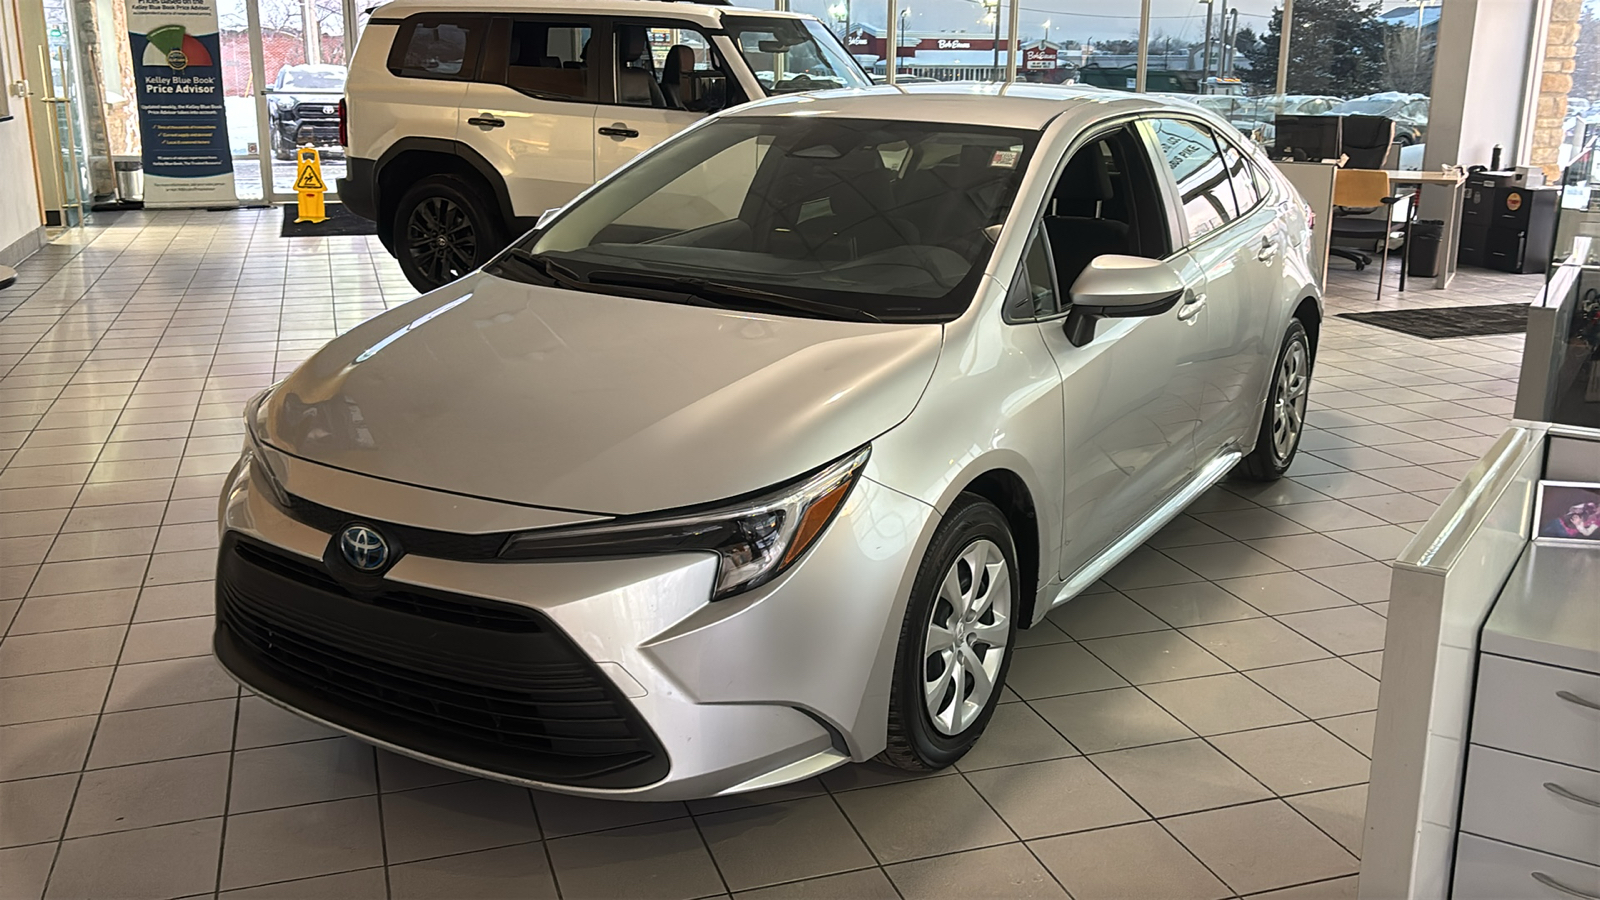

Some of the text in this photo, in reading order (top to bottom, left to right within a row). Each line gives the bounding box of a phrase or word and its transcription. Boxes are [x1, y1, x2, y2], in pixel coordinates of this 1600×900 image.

[938, 40, 970, 49] Bob Evans
[1027, 51, 1056, 60] Bob Evans
[145, 76, 171, 85] Kelley
[172, 76, 192, 84] Blue
[146, 84, 215, 94] Price Advisor
[1178, 144, 1201, 158] PIKE
